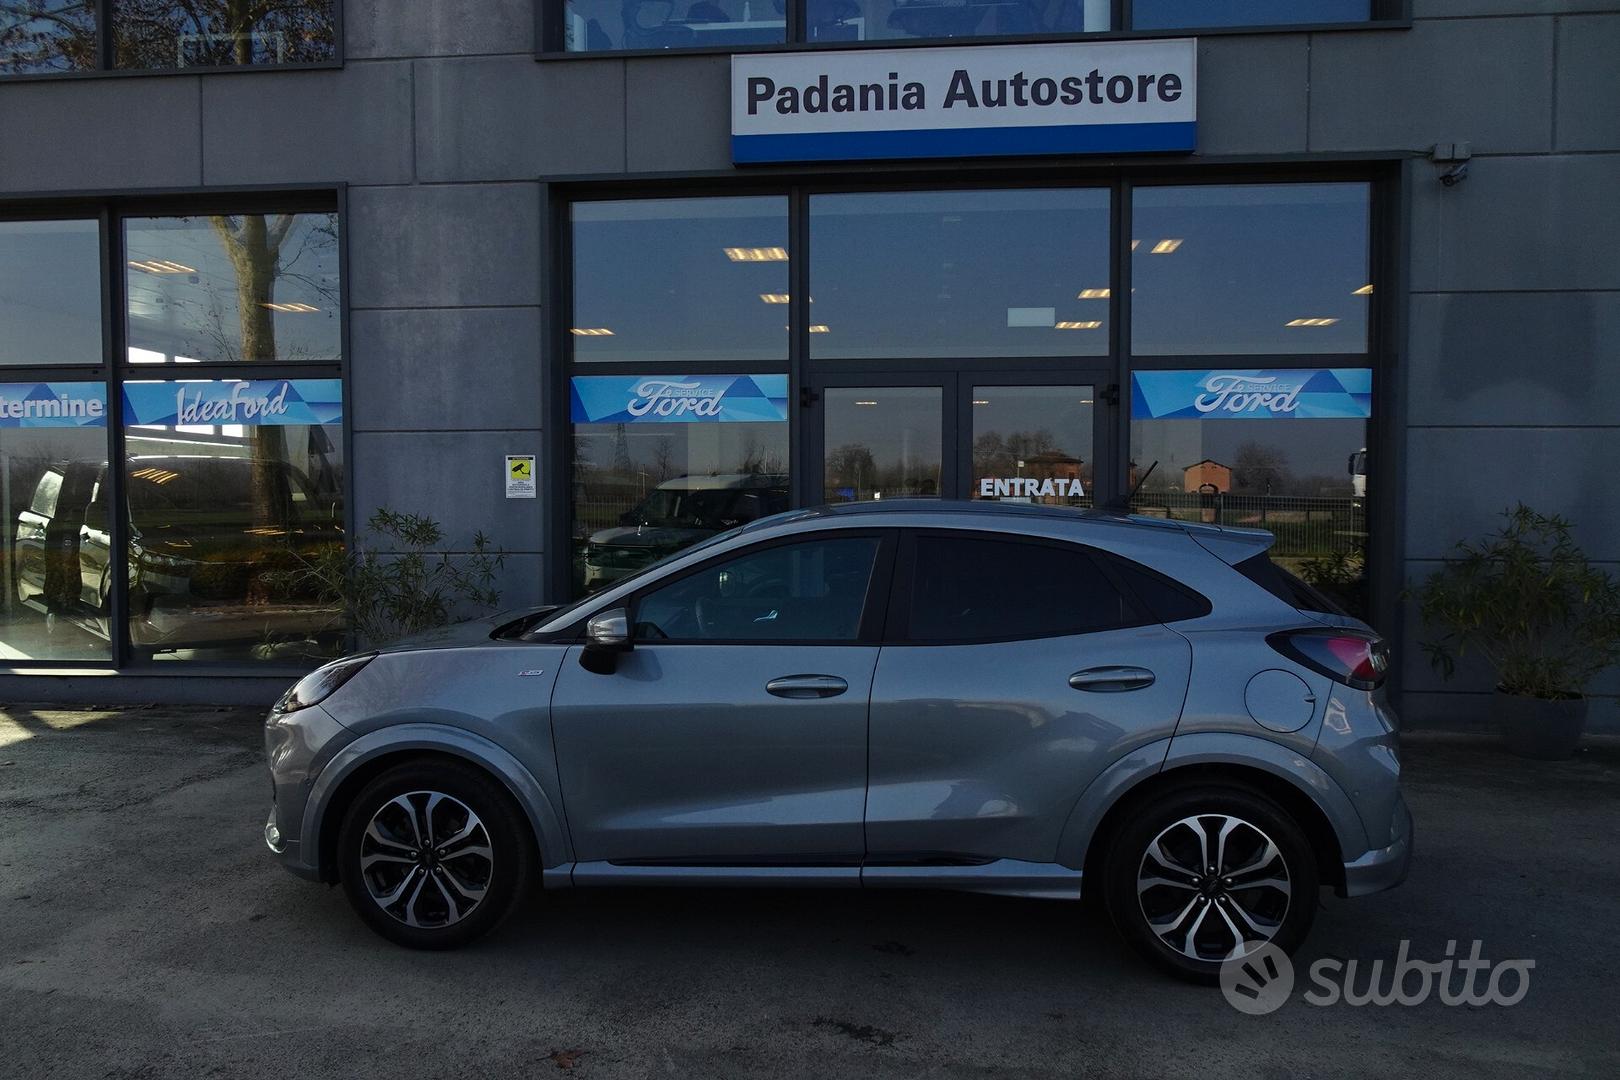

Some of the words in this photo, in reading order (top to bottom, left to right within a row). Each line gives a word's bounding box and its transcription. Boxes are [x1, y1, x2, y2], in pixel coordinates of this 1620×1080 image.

[746, 71, 926, 116] Padania
[942, 68, 1183, 110] Autostore
[627, 381, 725, 417] Ford
[1194, 375, 1304, 413] Ford
[980, 478, 1085, 497] ENTRATA
